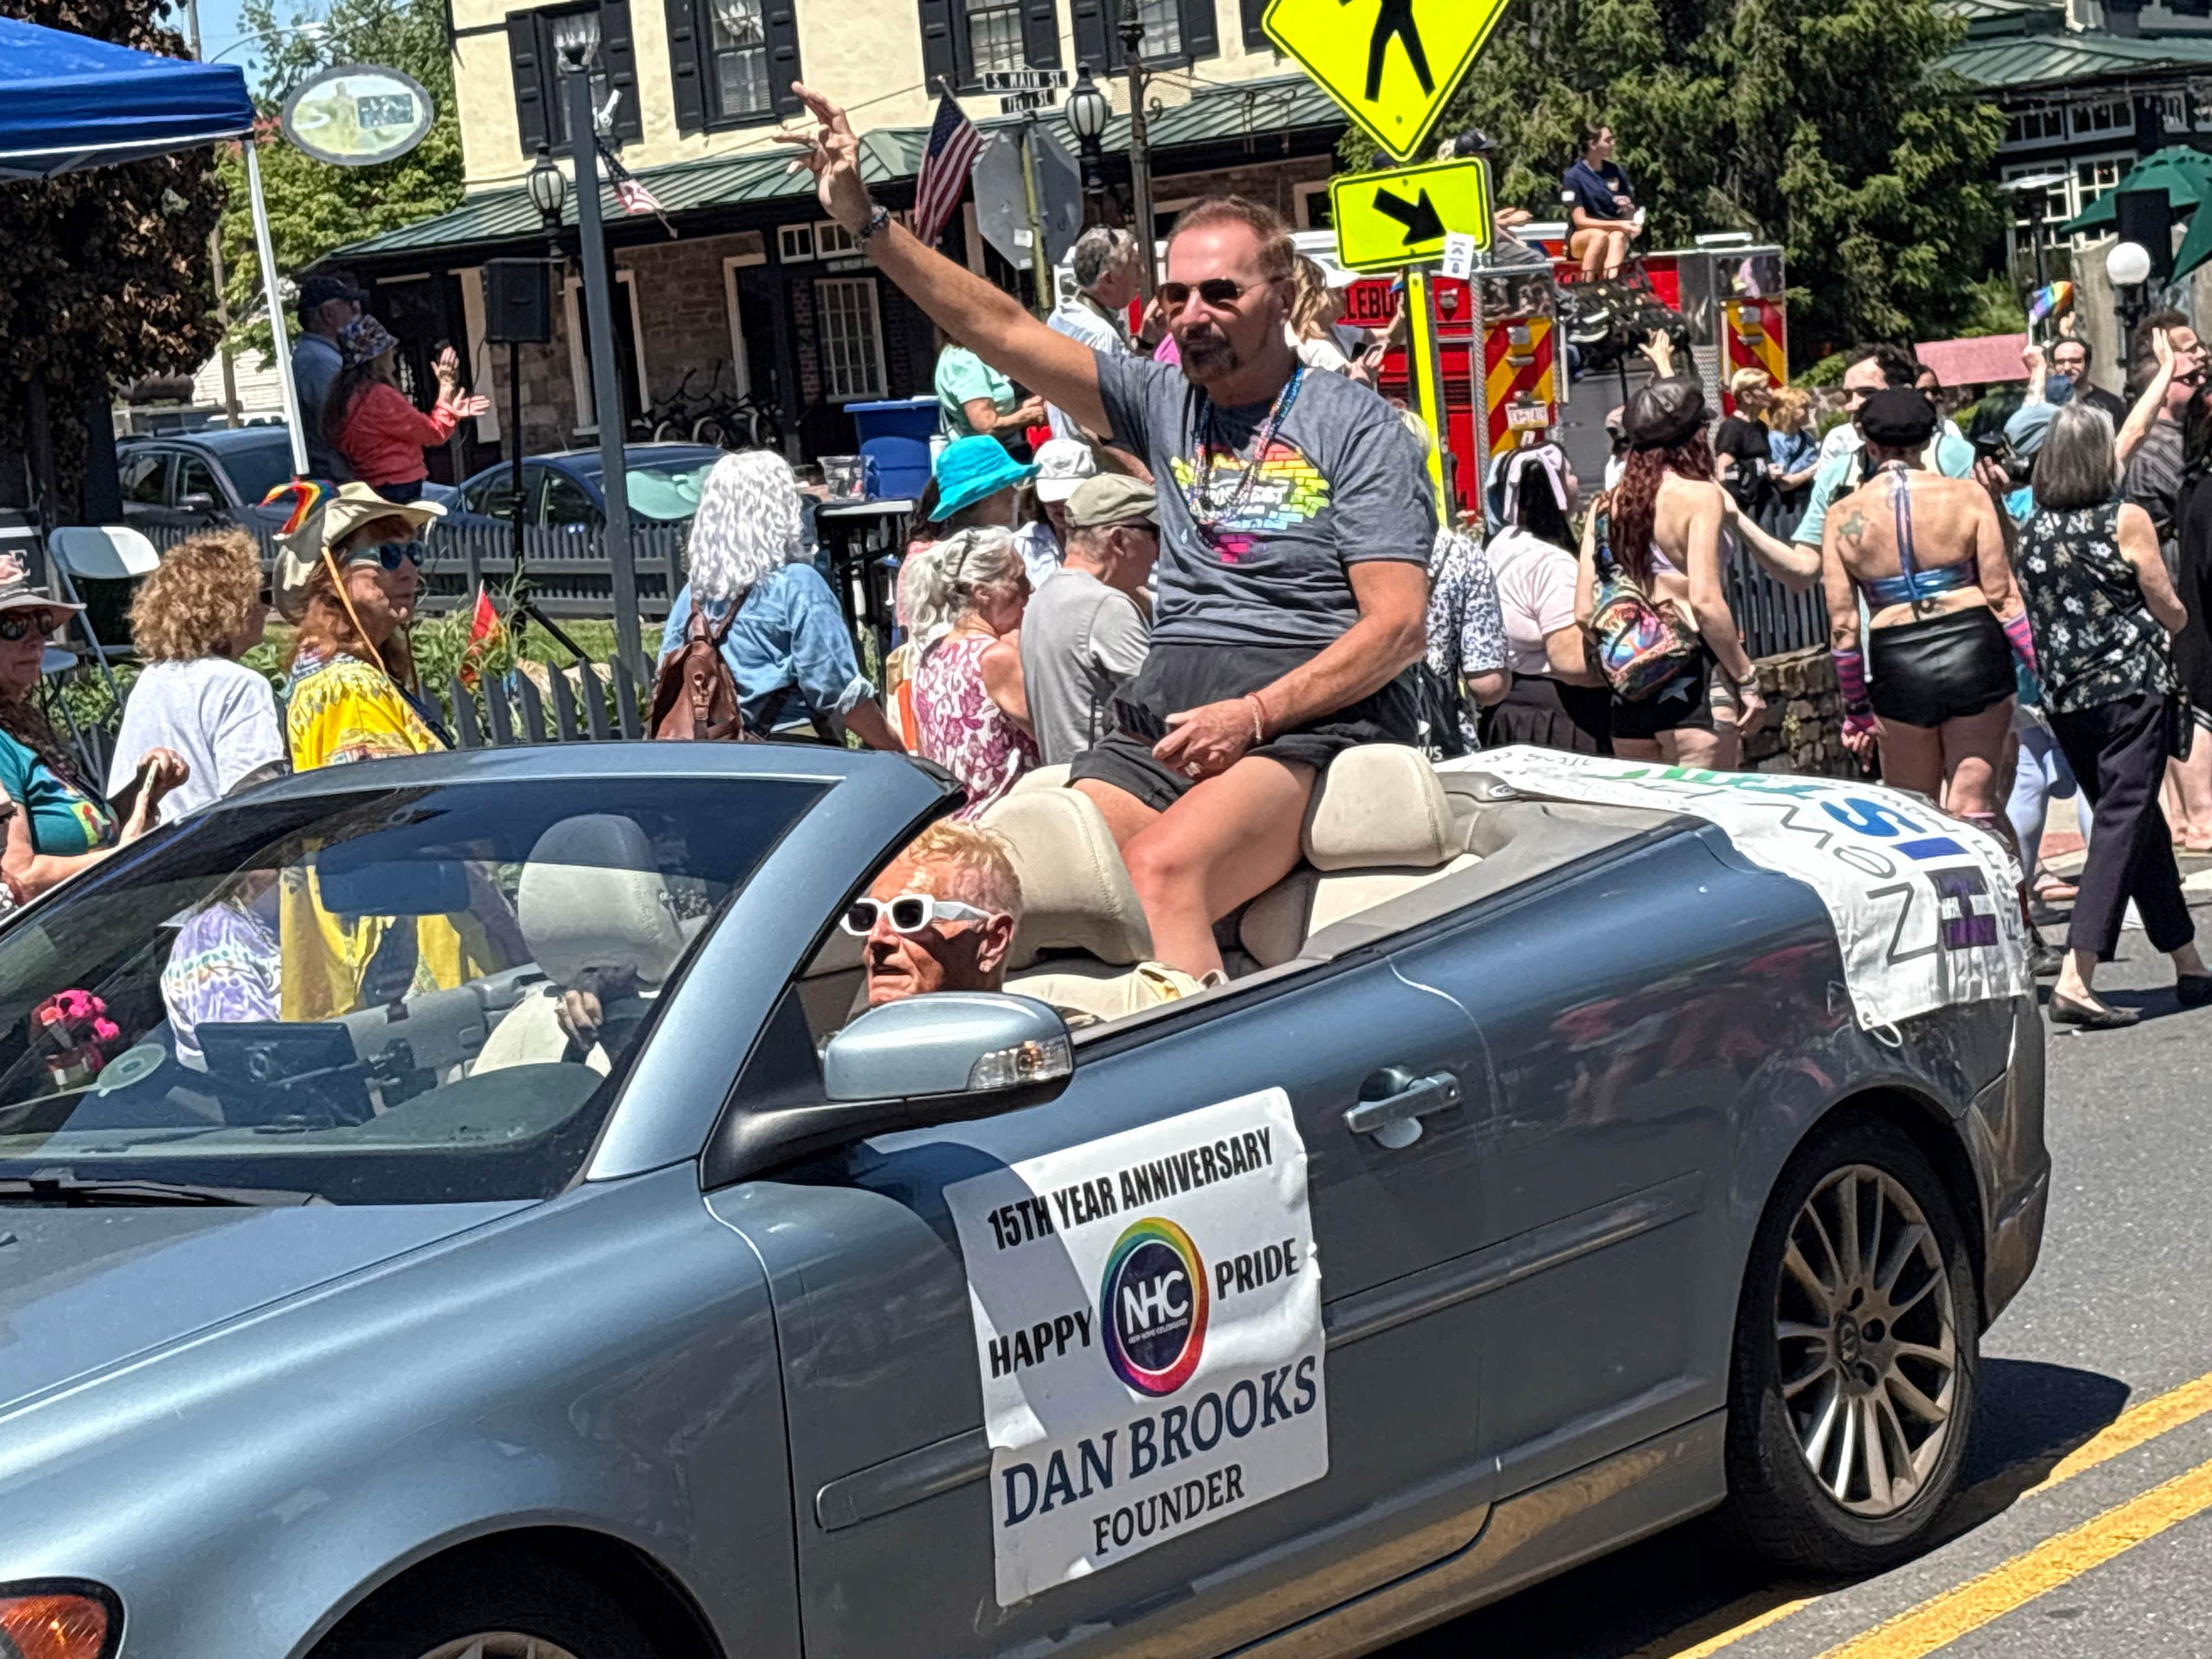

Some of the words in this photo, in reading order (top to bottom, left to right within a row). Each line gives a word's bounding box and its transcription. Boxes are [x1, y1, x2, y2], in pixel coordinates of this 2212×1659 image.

[1010, 73, 1040, 88] MAIN
[1345, 285, 1397, 319] LEBU
[987, 1195, 1054, 1250] 15TH
[1052, 1176, 1116, 1230] YEAR
[1120, 1126, 1274, 1208] ANNIVERSARY
[988, 1306, 1093, 1378] HAPPY
[1215, 1238, 1300, 1300] PRIDE
[1122, 1270, 1189, 1335] NHC
[1002, 1428, 1116, 1528] DAN
[1129, 1354, 1318, 1479] BROOKS
[1093, 1463, 1245, 1556] FOUNDER
